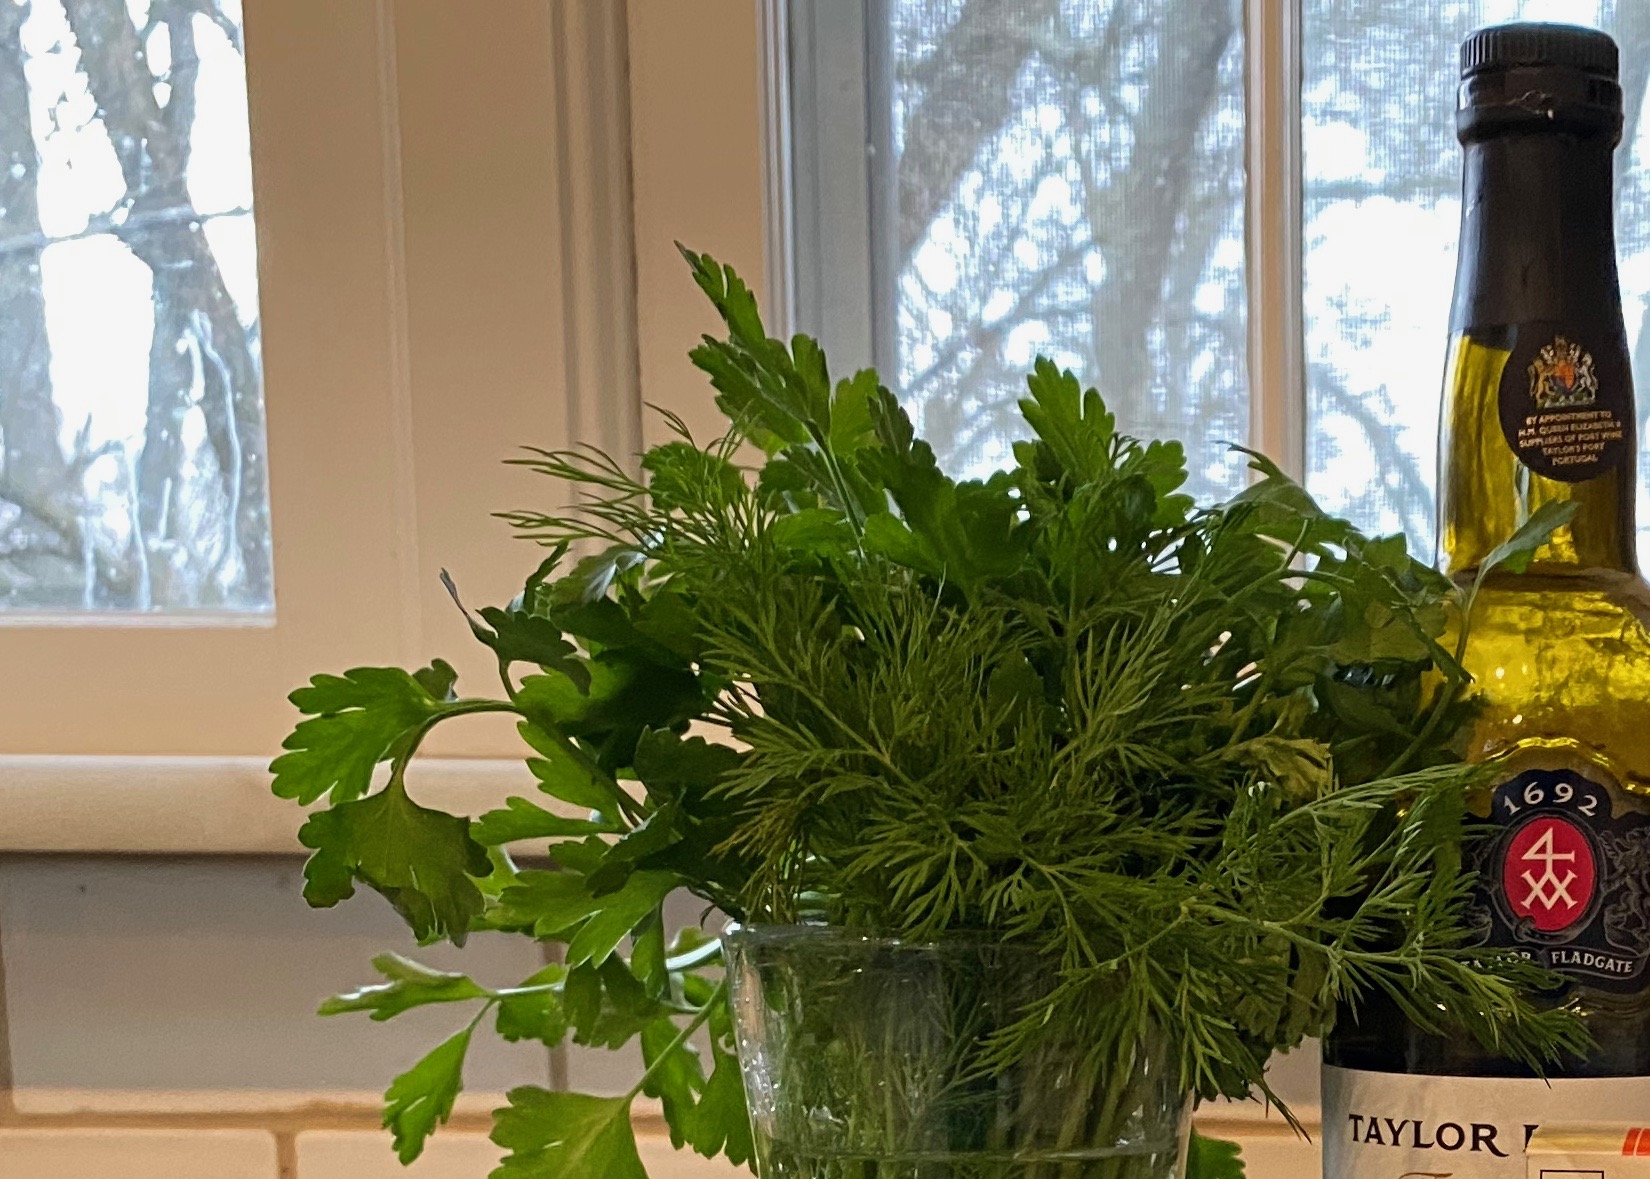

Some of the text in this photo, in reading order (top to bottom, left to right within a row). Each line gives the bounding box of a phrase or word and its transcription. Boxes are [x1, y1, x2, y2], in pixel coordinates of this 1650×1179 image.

[1503, 781, 1598, 817] 1692
[1551, 951, 1633, 973] FLADGATE
[1348, 1113, 1510, 1158] TAYLOR
